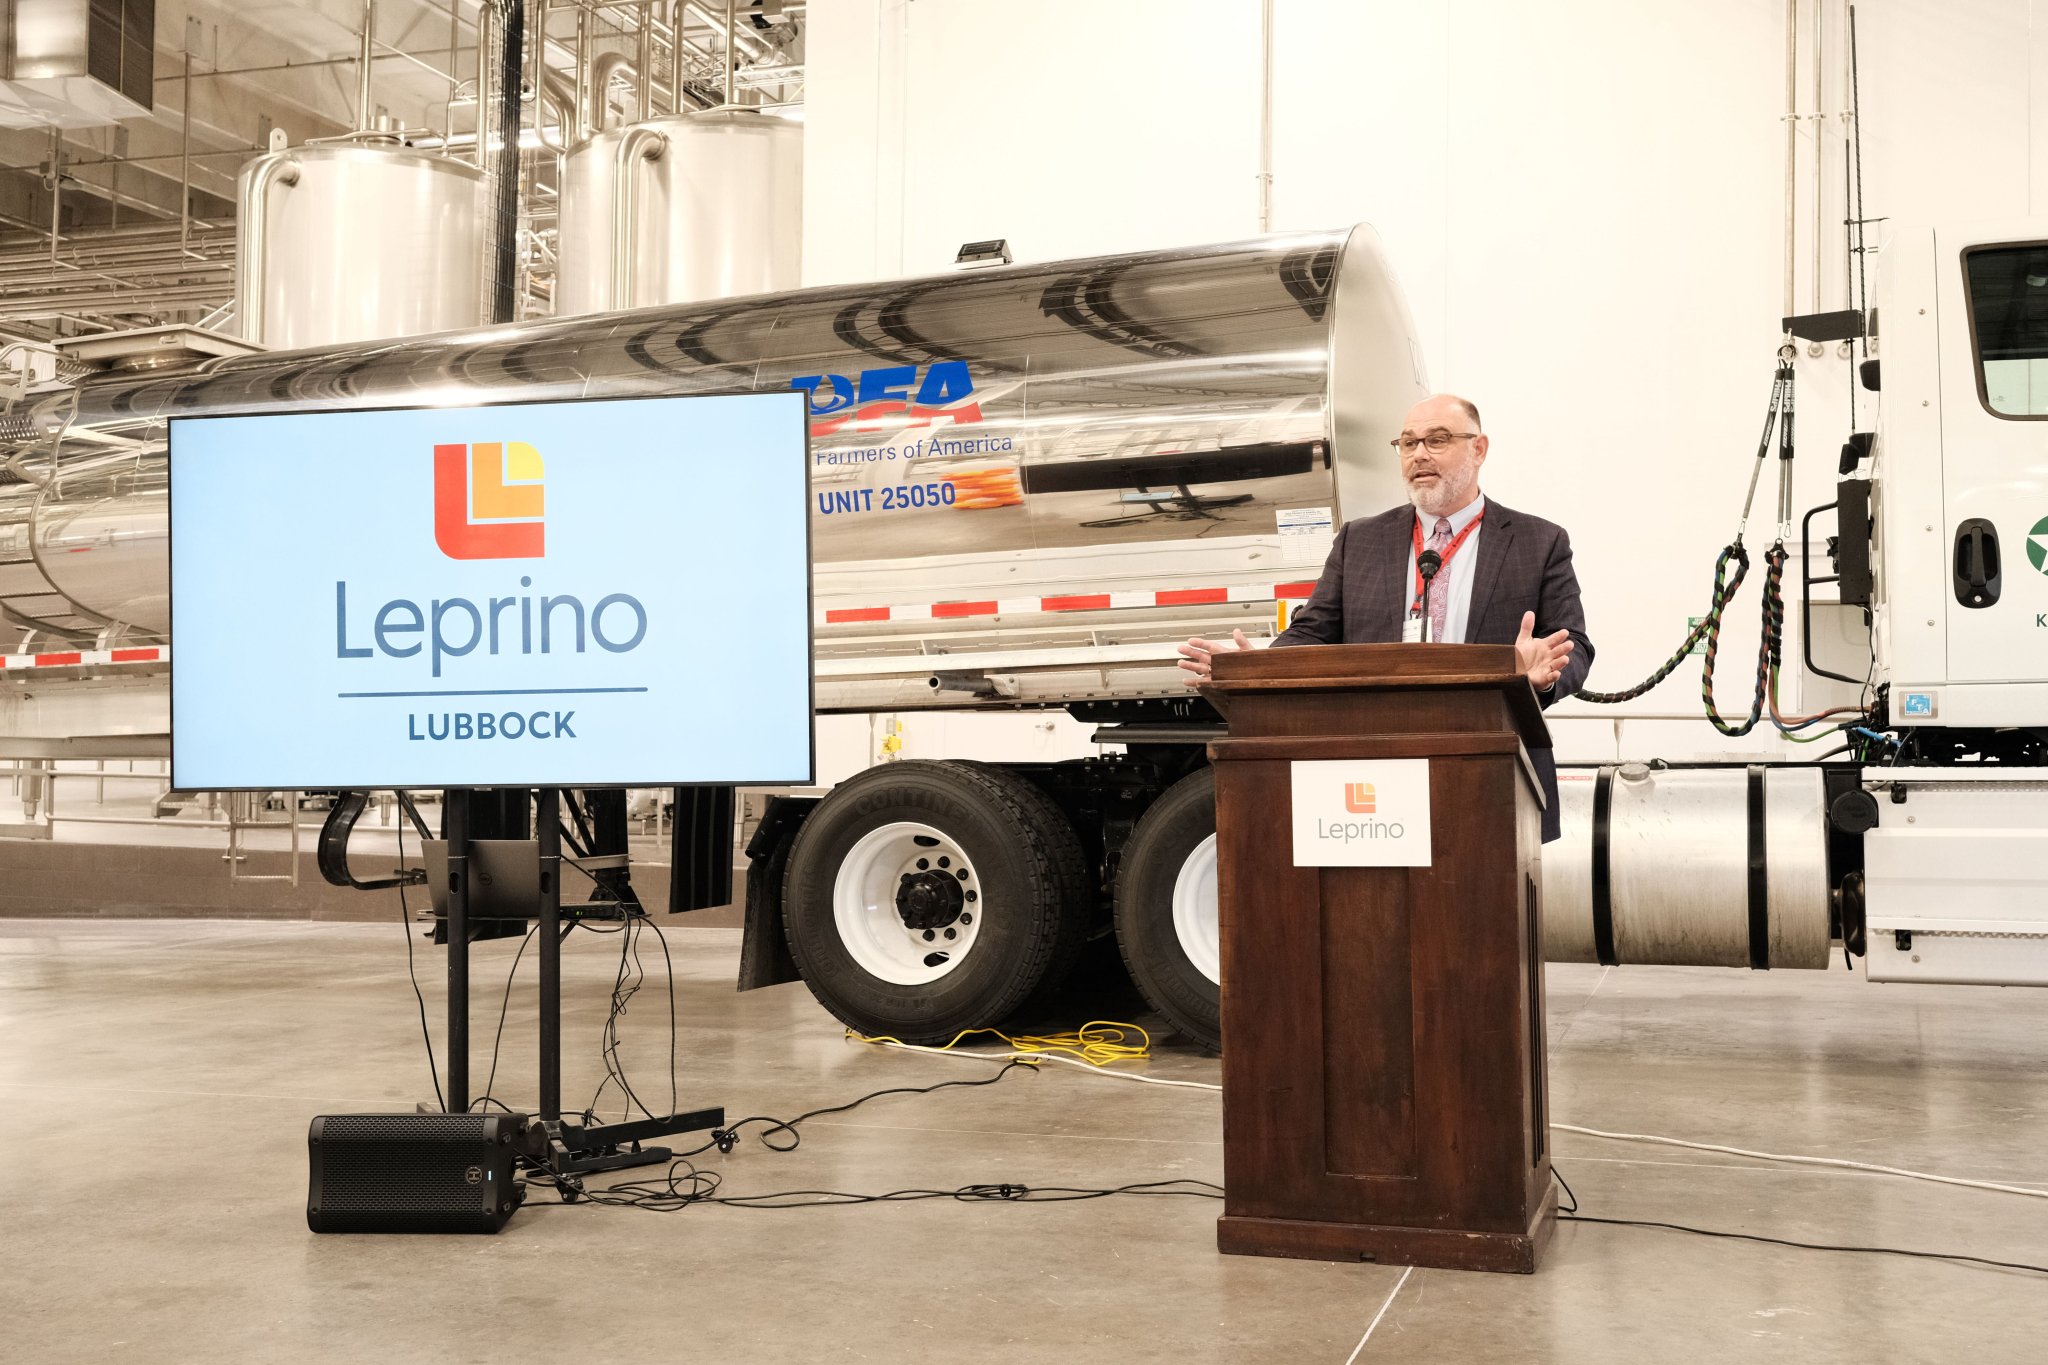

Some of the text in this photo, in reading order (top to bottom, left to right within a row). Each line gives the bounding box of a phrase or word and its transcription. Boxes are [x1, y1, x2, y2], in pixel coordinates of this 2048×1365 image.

[816, 434, 1012, 466] Farmers of America
[818, 482, 956, 515] UNIT 25050
[336, 575, 648, 678] Leprino
[408, 711, 577, 741] LUBBOCK
[1318, 817, 1405, 844] Leprino
